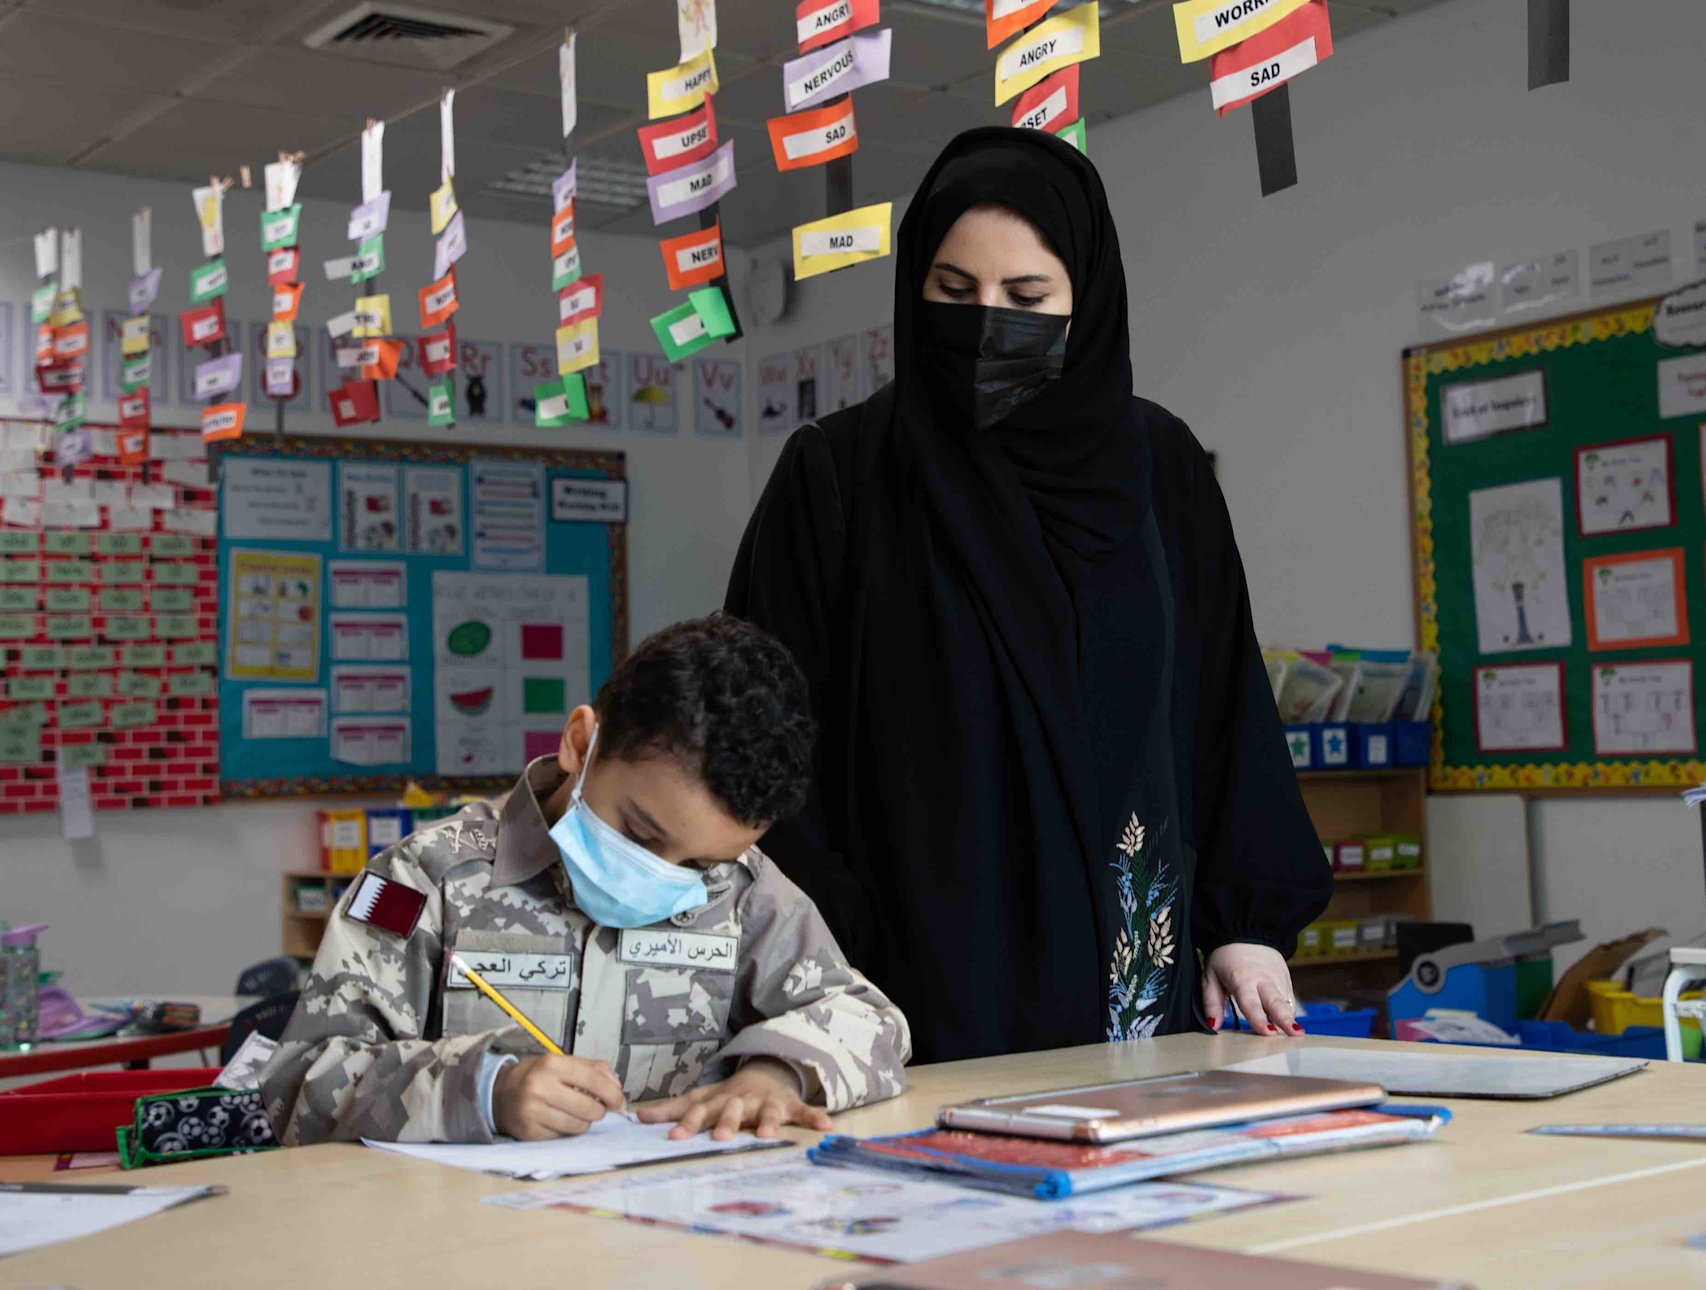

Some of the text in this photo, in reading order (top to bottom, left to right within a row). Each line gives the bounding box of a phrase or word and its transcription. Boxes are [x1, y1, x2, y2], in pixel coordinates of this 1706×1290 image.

[815, 3, 850, 29] ANGRY
[1214, 0, 1269, 28] WORR
[1019, 39, 1057, 67] ANGRY
[803, 50, 854, 93] NERVOUS
[1250, 63, 1280, 87] SAD
[825, 125, 846, 143] SAD
[689, 174, 713, 193] MAD
[829, 235, 854, 249] MAD
[629, 933, 732, 962] الحرس الأميري
[457, 958, 566, 981] تركي العج
